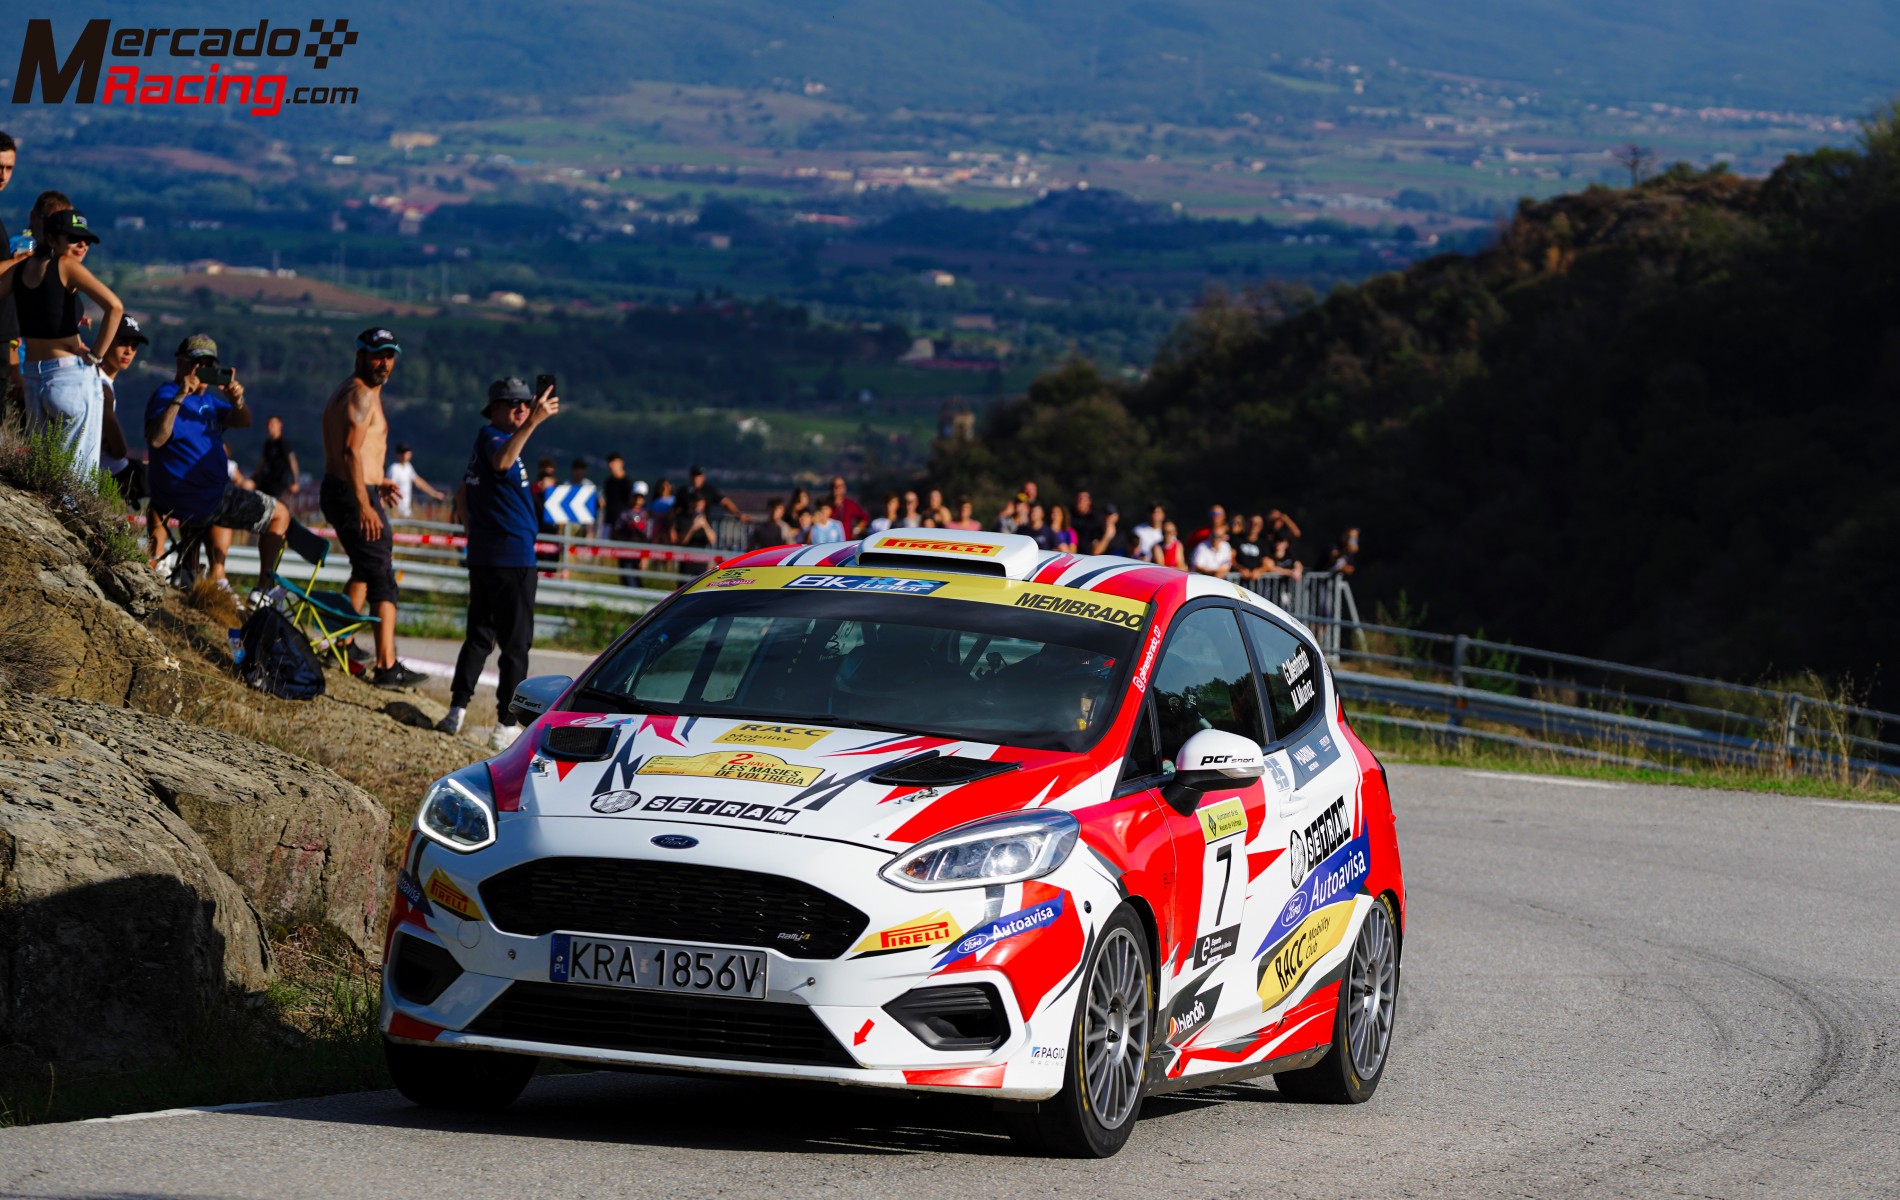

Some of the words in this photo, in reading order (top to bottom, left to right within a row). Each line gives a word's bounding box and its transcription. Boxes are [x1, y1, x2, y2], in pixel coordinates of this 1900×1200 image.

[883, 538, 994, 554] PIRELLI
[1014, 592, 1145, 628] MEMBRADO
[729, 733, 792, 743] Mobility
[740, 724, 827, 737] RACC
[714, 769, 736, 778] DE
[720, 763, 748, 772] LES
[749, 765, 802, 778] MASIES
[747, 760, 779, 768] RALLY
[648, 797, 797, 824] SETRAM
[1305, 800, 1351, 865] SETRAM
[1215, 843, 1233, 927] 7
[1309, 850, 1367, 911] Autoavisa
[430, 878, 469, 913] PIRELLI
[880, 922, 950, 948] PIRELLI
[991, 907, 1054, 941] Autoavisa
[1307, 916, 1331, 943] Mobility
[964, 937, 983, 950] Ford
[1305, 940, 1318, 959] Club
[554, 963, 566, 974] PL
[571, 941, 638, 983] KRA
[653, 949, 761, 993] 1856V
[1275, 933, 1306, 992] RACC
[1178, 1000, 1205, 1034] blendio
[1041, 1047, 1066, 1060] PAGID
